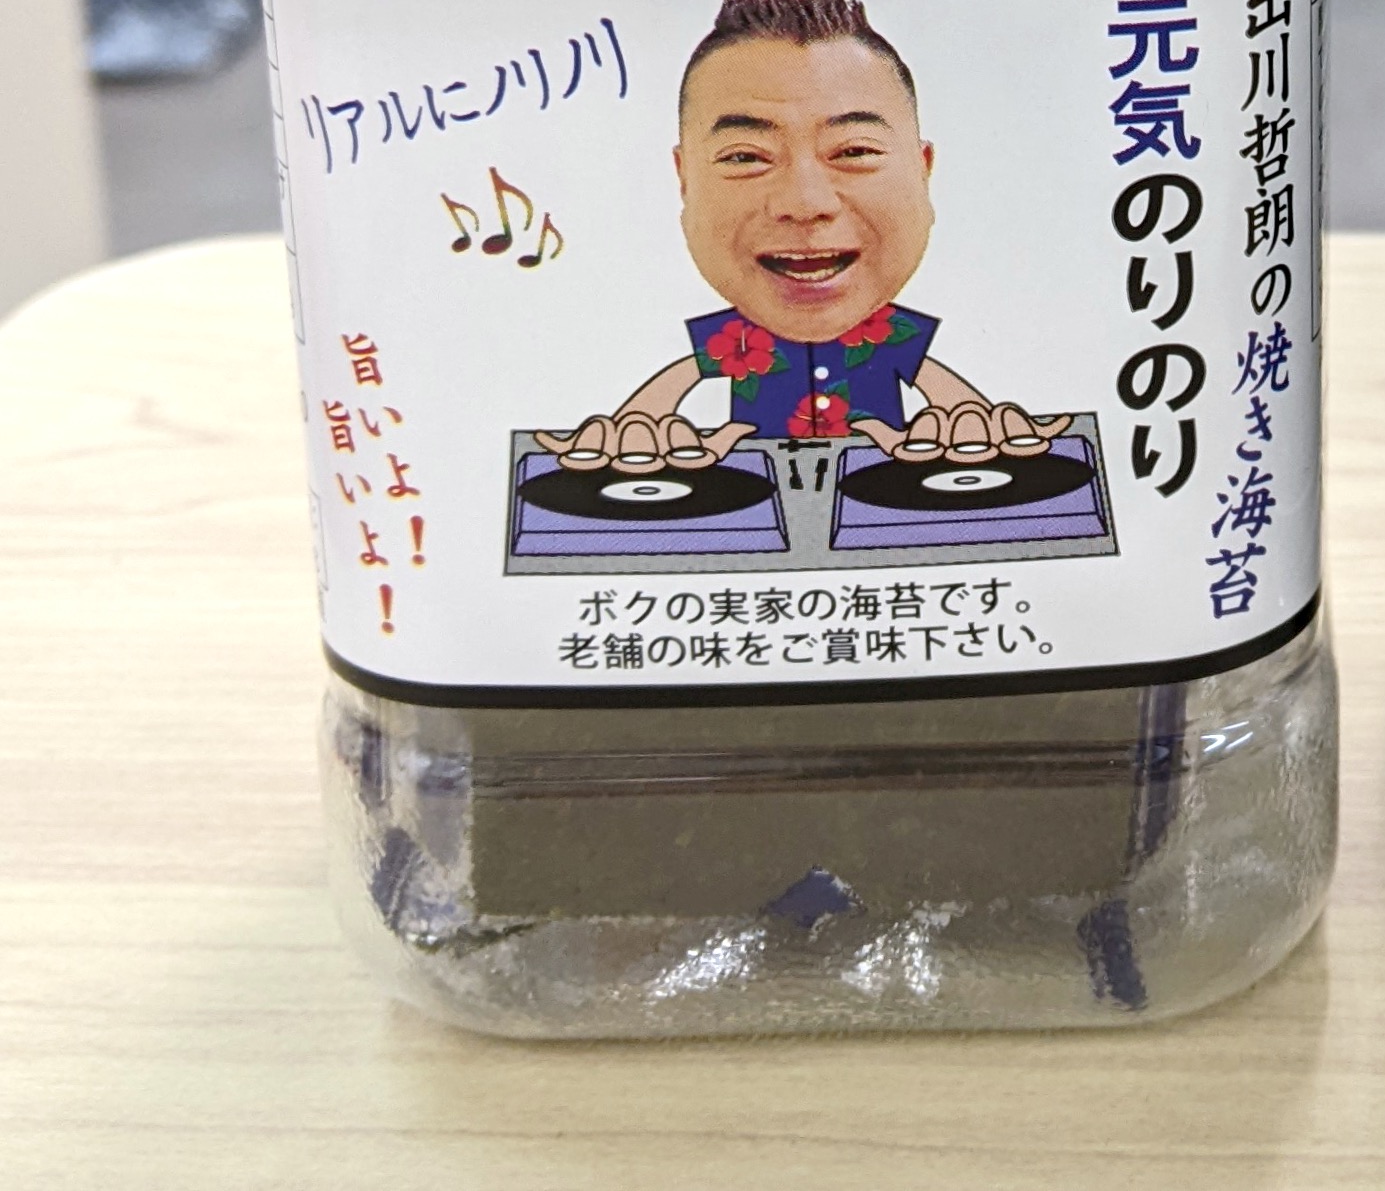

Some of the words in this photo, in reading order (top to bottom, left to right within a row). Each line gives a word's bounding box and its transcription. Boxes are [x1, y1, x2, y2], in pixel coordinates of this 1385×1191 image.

[300, 17, 629, 174] リアルにノリノリ
[579, 577, 1031, 626] ボクの実家の海苔です。
[559, 621, 1054, 670] 老舗の味をご賞味下さい。
